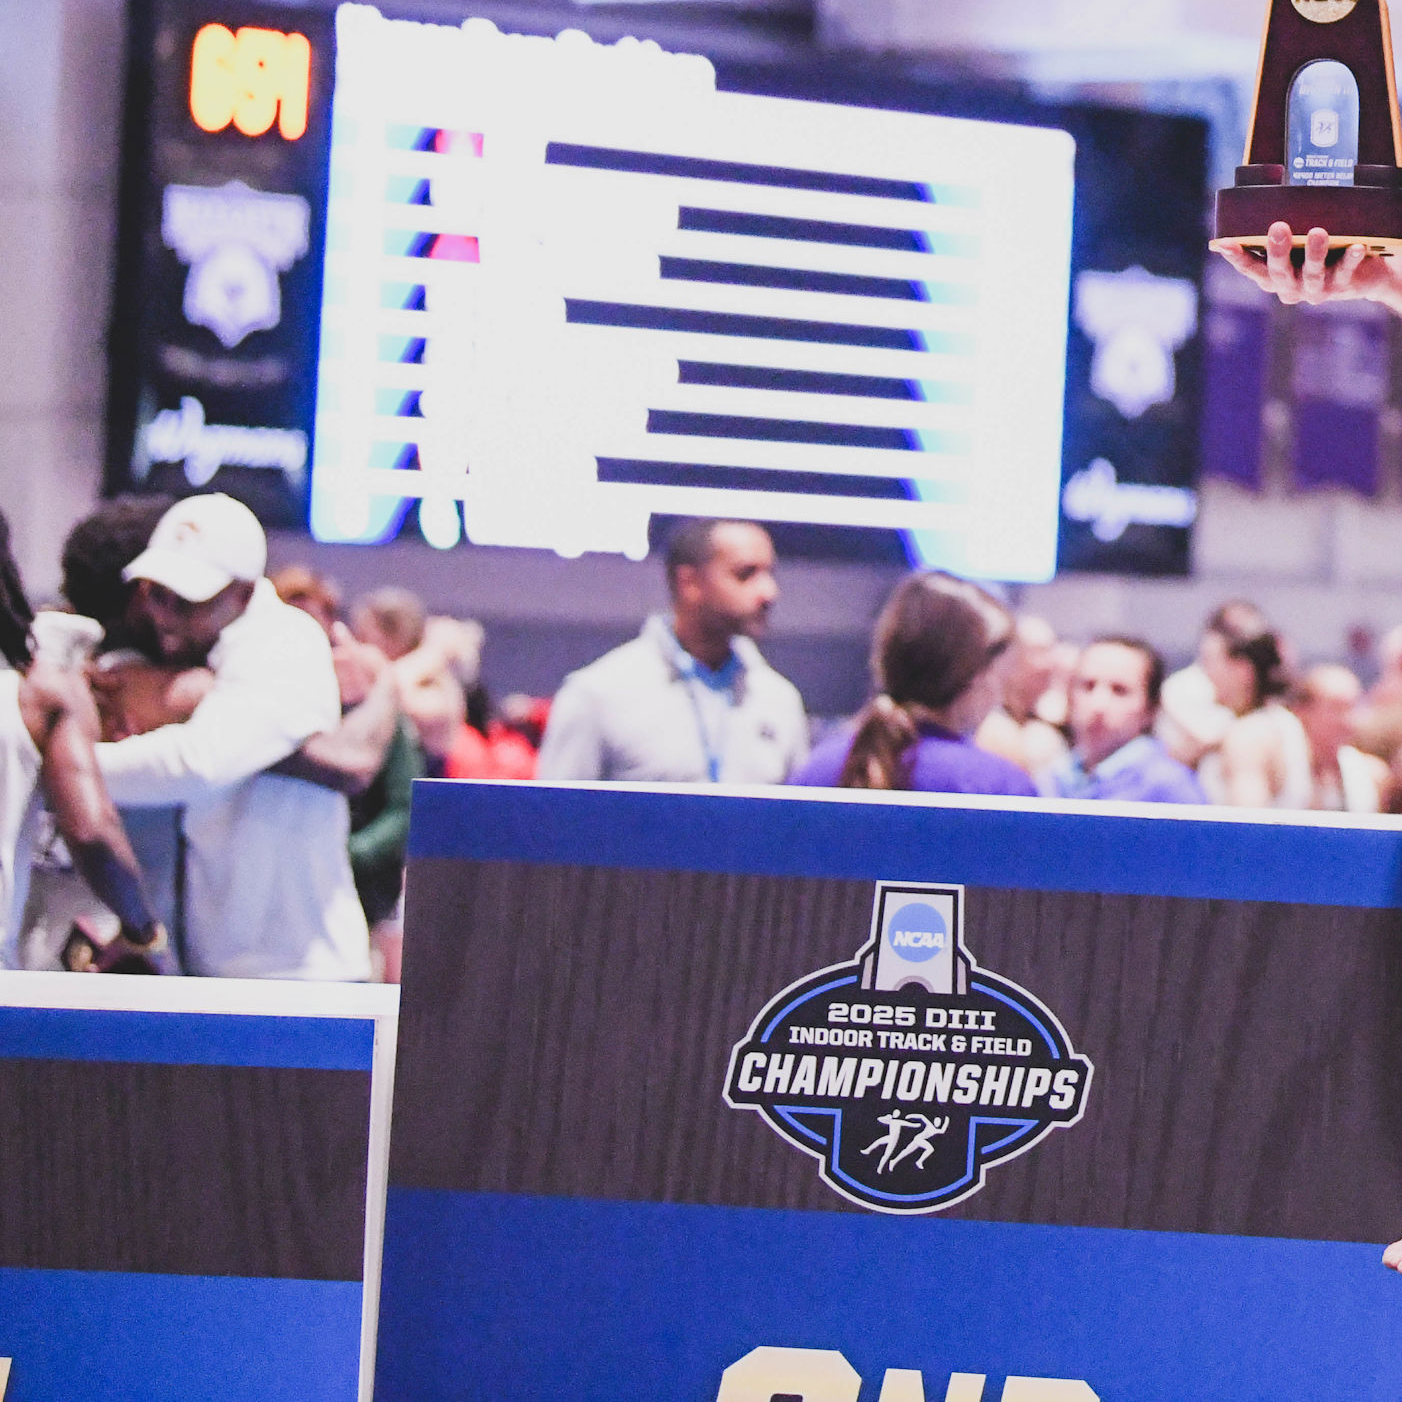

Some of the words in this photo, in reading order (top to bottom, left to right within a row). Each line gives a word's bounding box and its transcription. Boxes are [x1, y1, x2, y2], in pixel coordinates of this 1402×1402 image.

[892, 930, 945, 950] NCAA
[827, 1002, 916, 1027] 2025
[926, 1008, 997, 1031] DIII
[789, 1026, 873, 1048] INDOOR
[877, 1030, 946, 1052] TRACK
[951, 1033, 966, 1052] &
[971, 1035, 1032, 1057] FIELD
[737, 1052, 1080, 1110] CHAMPIONSHIPS
